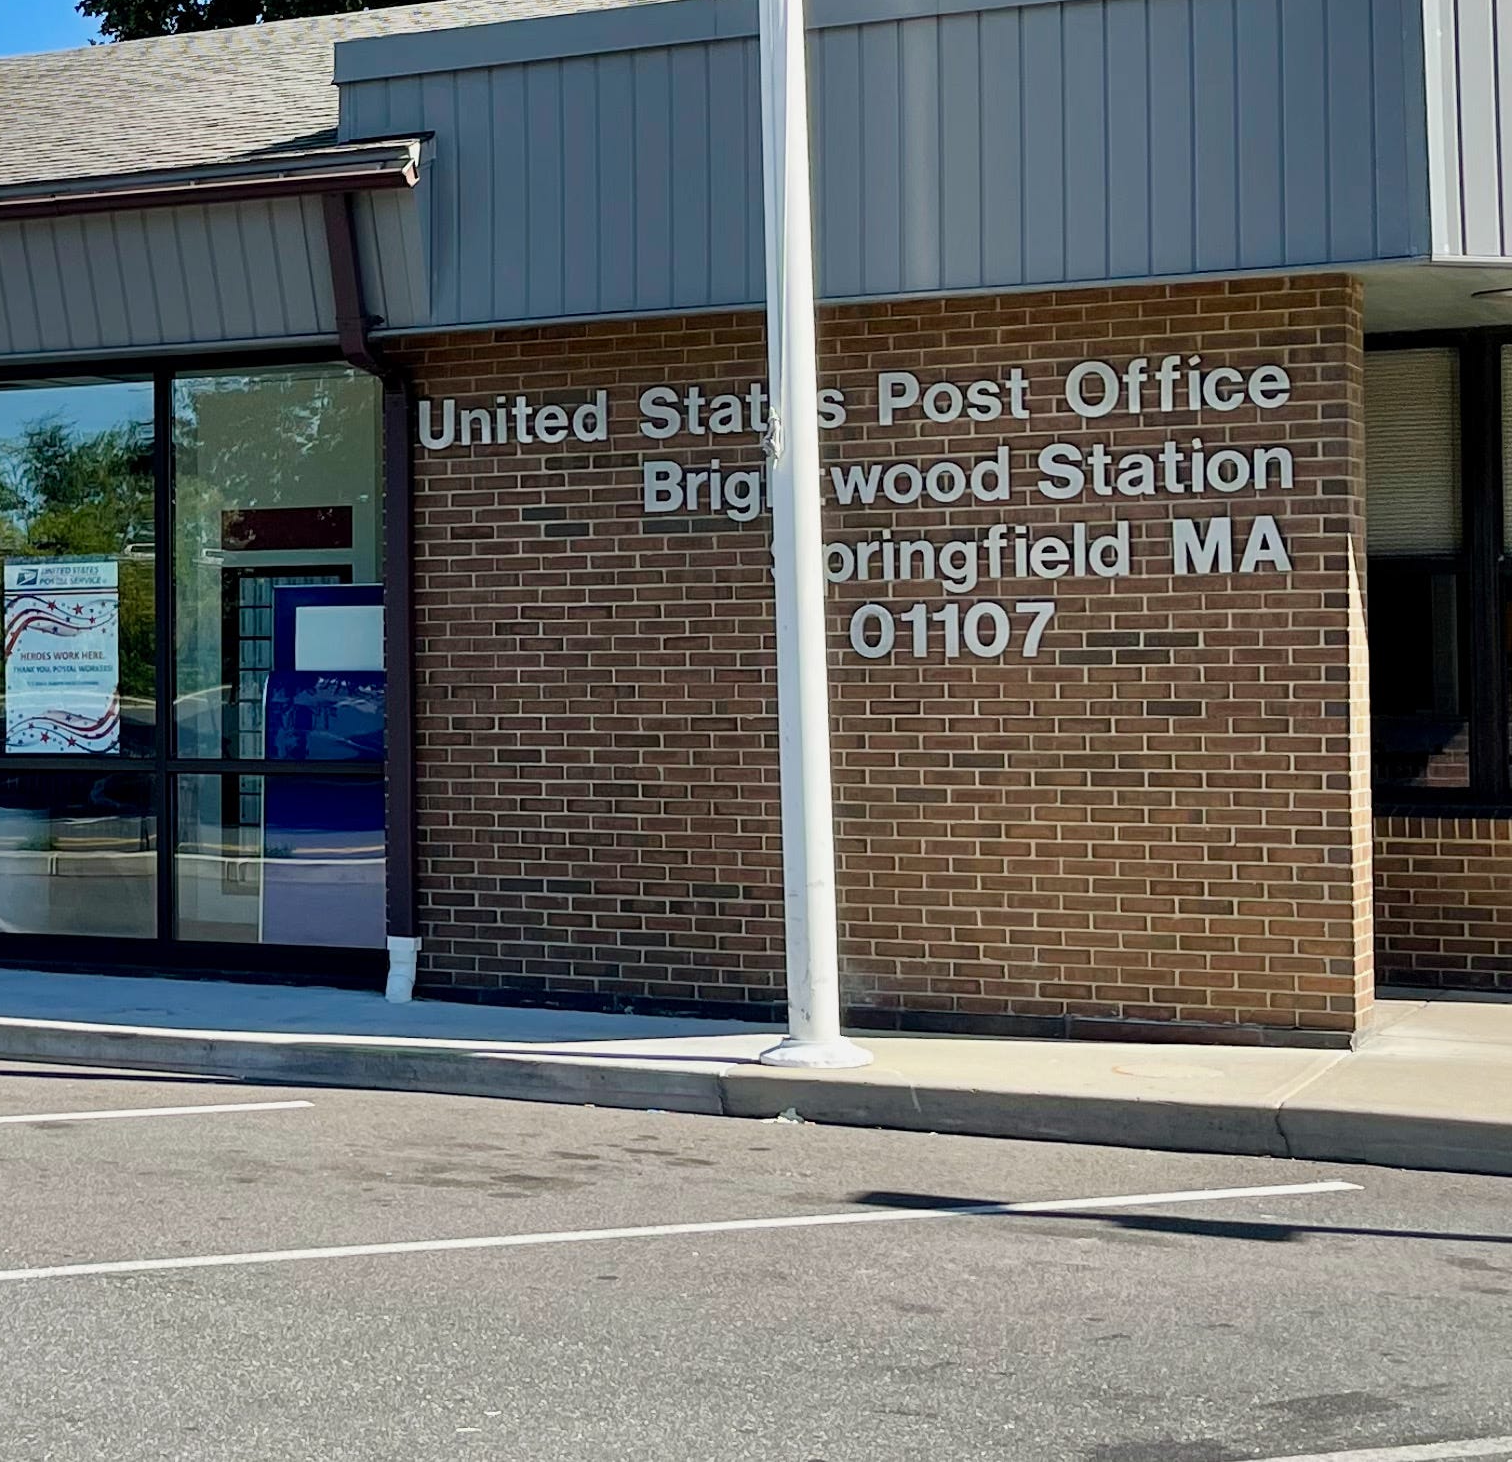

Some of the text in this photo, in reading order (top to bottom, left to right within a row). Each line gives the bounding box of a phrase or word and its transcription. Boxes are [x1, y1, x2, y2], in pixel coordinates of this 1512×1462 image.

[419, 354, 1290, 450] United Stats Post Office
[643, 438, 1294, 522] Brigwood Station
[771, 515, 1293, 596] pringfield MA
[20, 651, 51, 660] HEROES
[53, 651, 79, 660] WORK
[849, 601, 1056, 659] 01107
